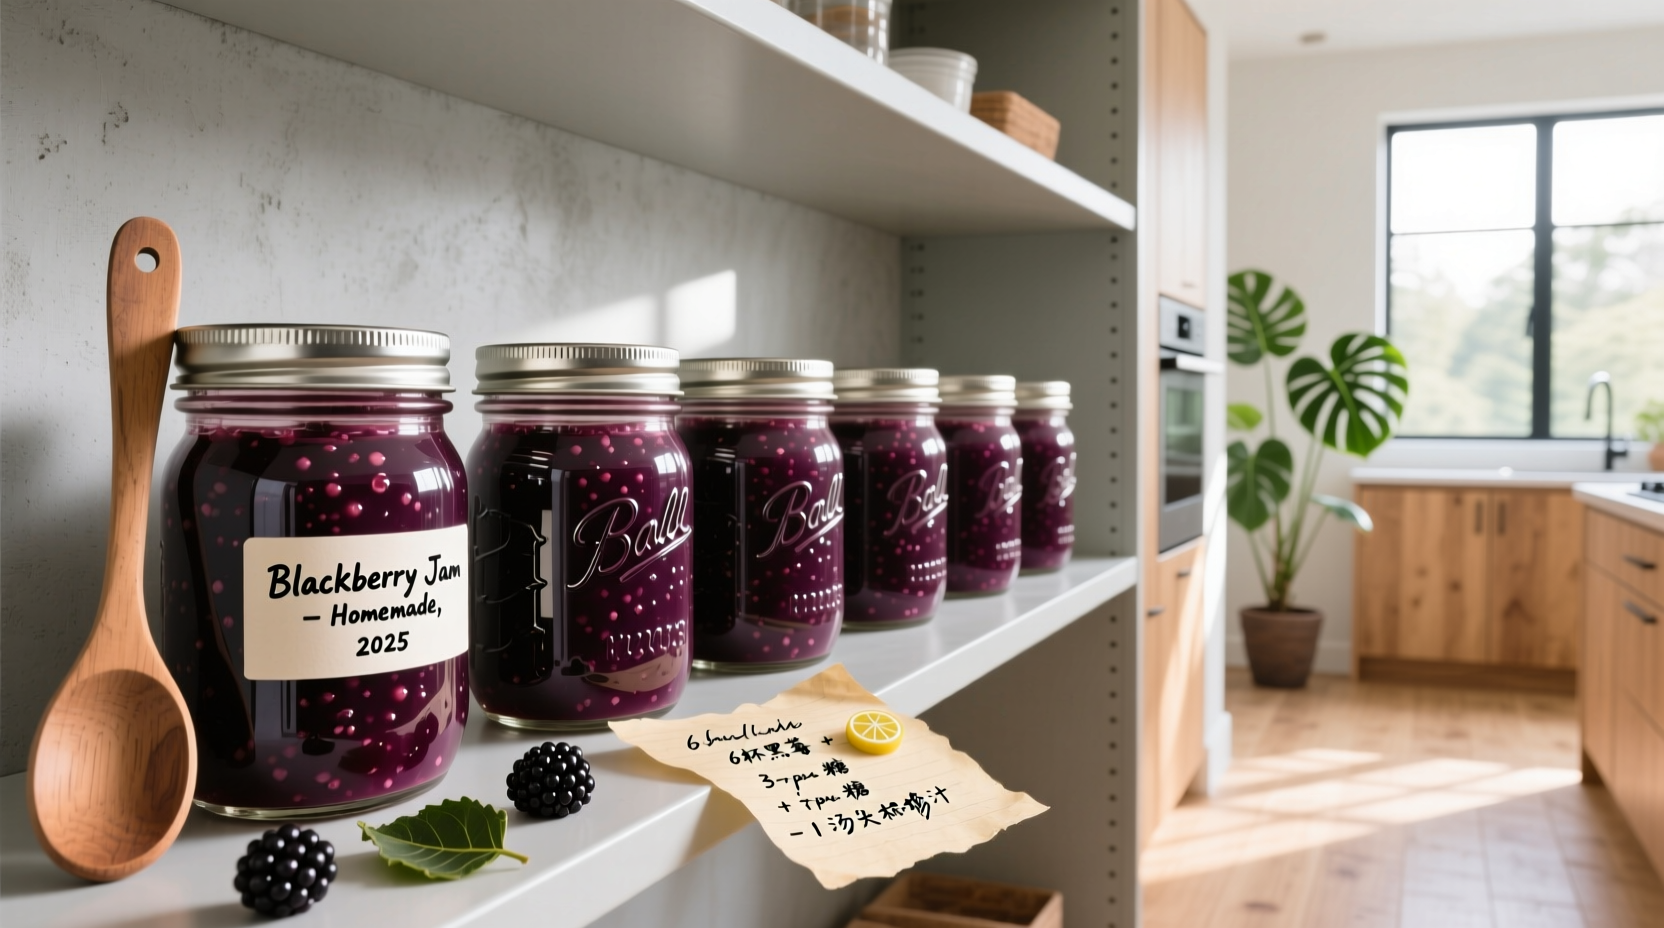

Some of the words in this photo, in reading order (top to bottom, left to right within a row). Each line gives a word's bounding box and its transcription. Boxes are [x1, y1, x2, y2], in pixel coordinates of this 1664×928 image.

[567, 486, 692, 589] Ball
[756, 472, 844, 558] Ball
[267, 561, 418, 599] Blackberry
[424, 554, 461, 586] Jam
[330, 591, 442, 627] Homemade,
[355, 630, 410, 657] 2025
